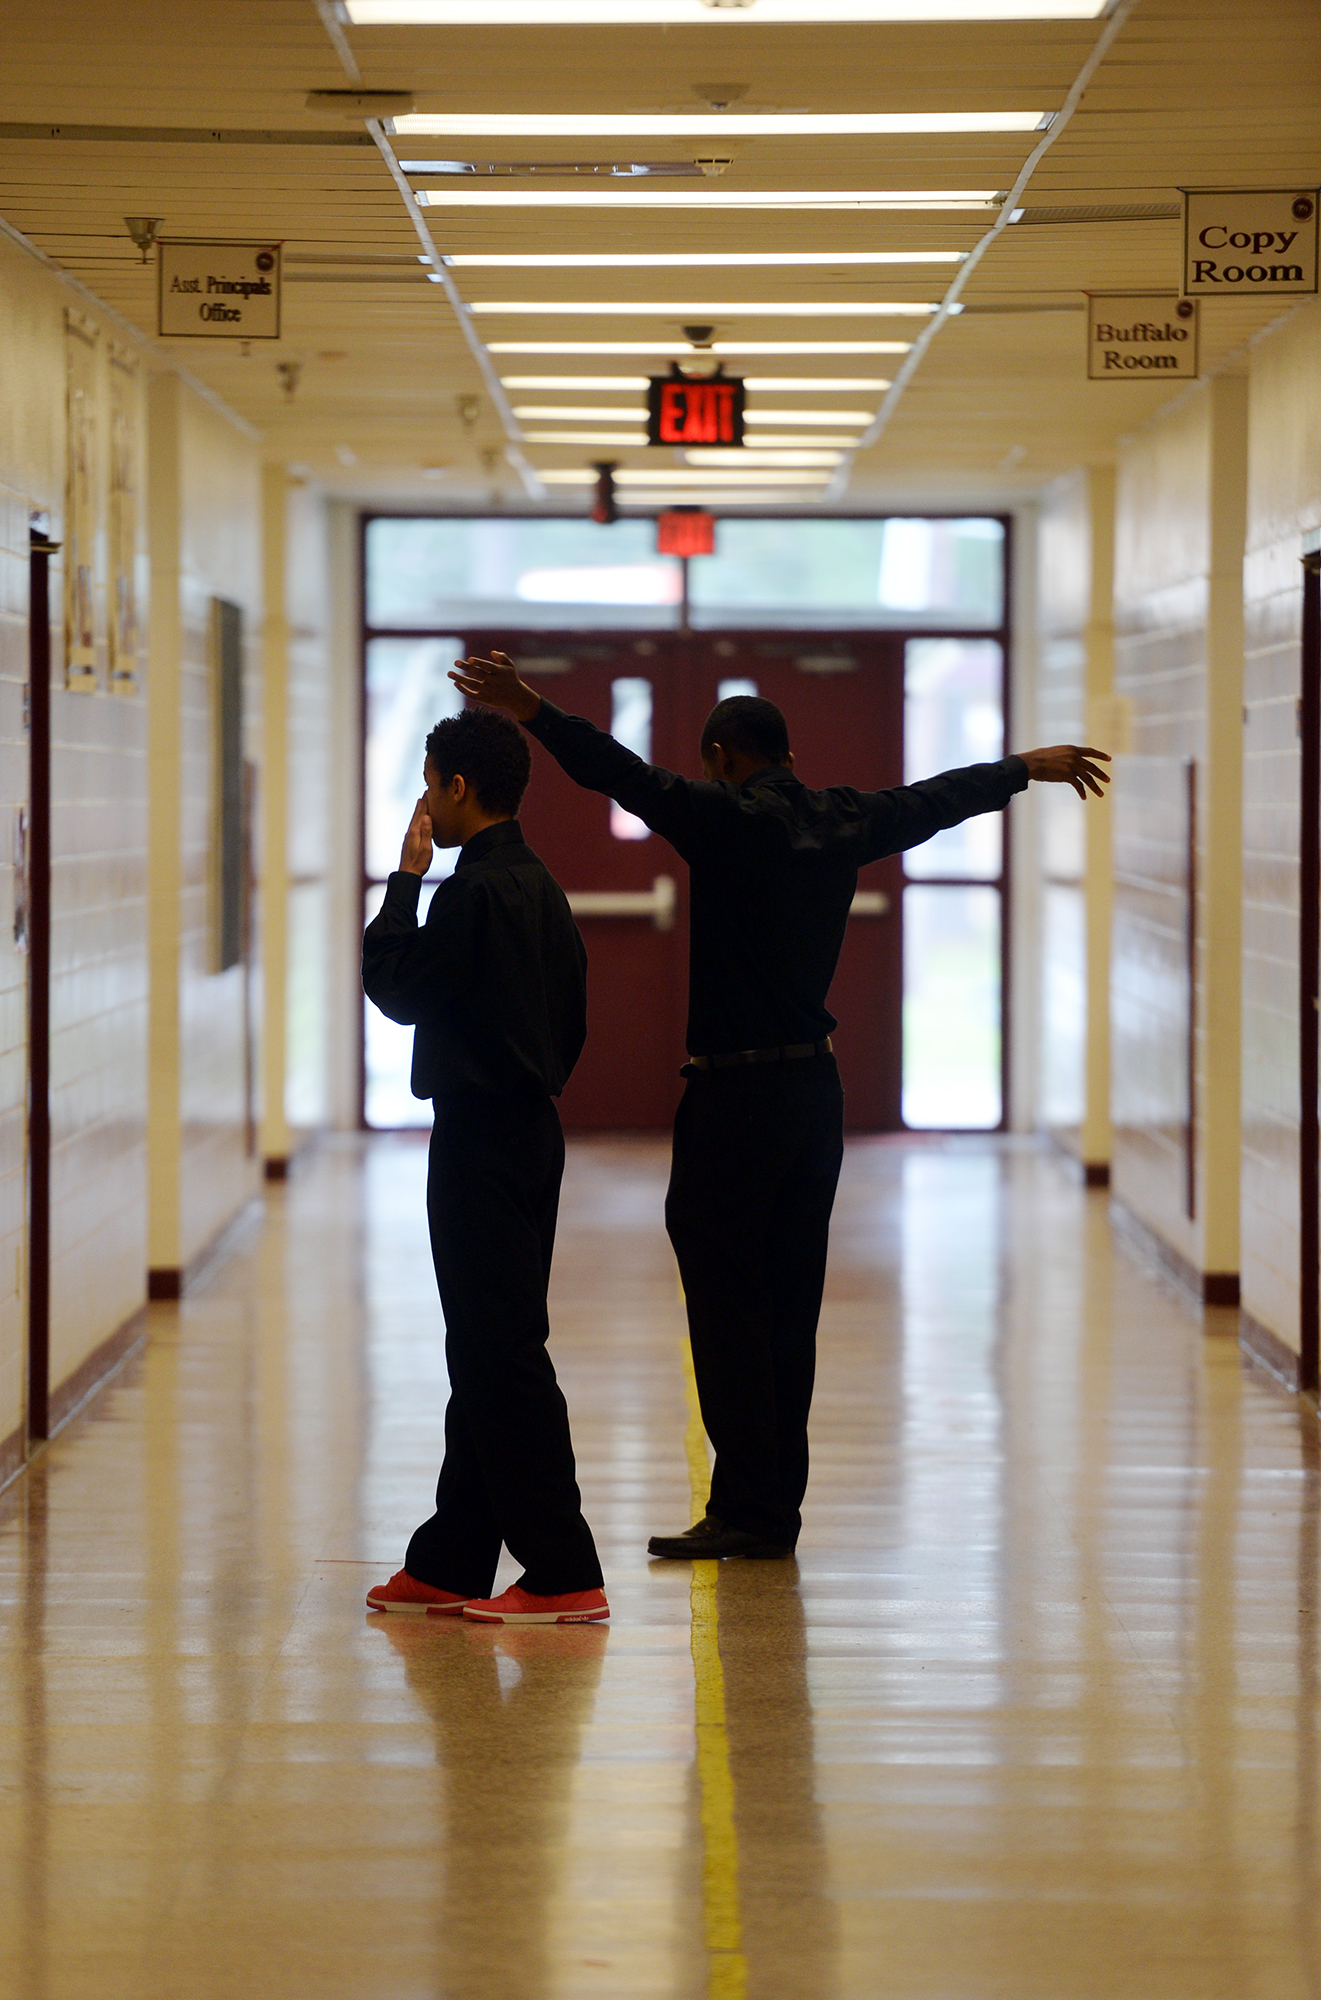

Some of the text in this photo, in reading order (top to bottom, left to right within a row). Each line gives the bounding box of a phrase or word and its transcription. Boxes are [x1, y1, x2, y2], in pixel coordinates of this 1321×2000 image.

[1199, 226, 1298, 254] Copy
[1192, 260, 1305, 283] Room
[199, 302, 242, 322] Office
[1096, 323, 1188, 343] Buffalo
[1103, 351, 1178, 370] Room
[659, 383, 736, 443] EXIT
